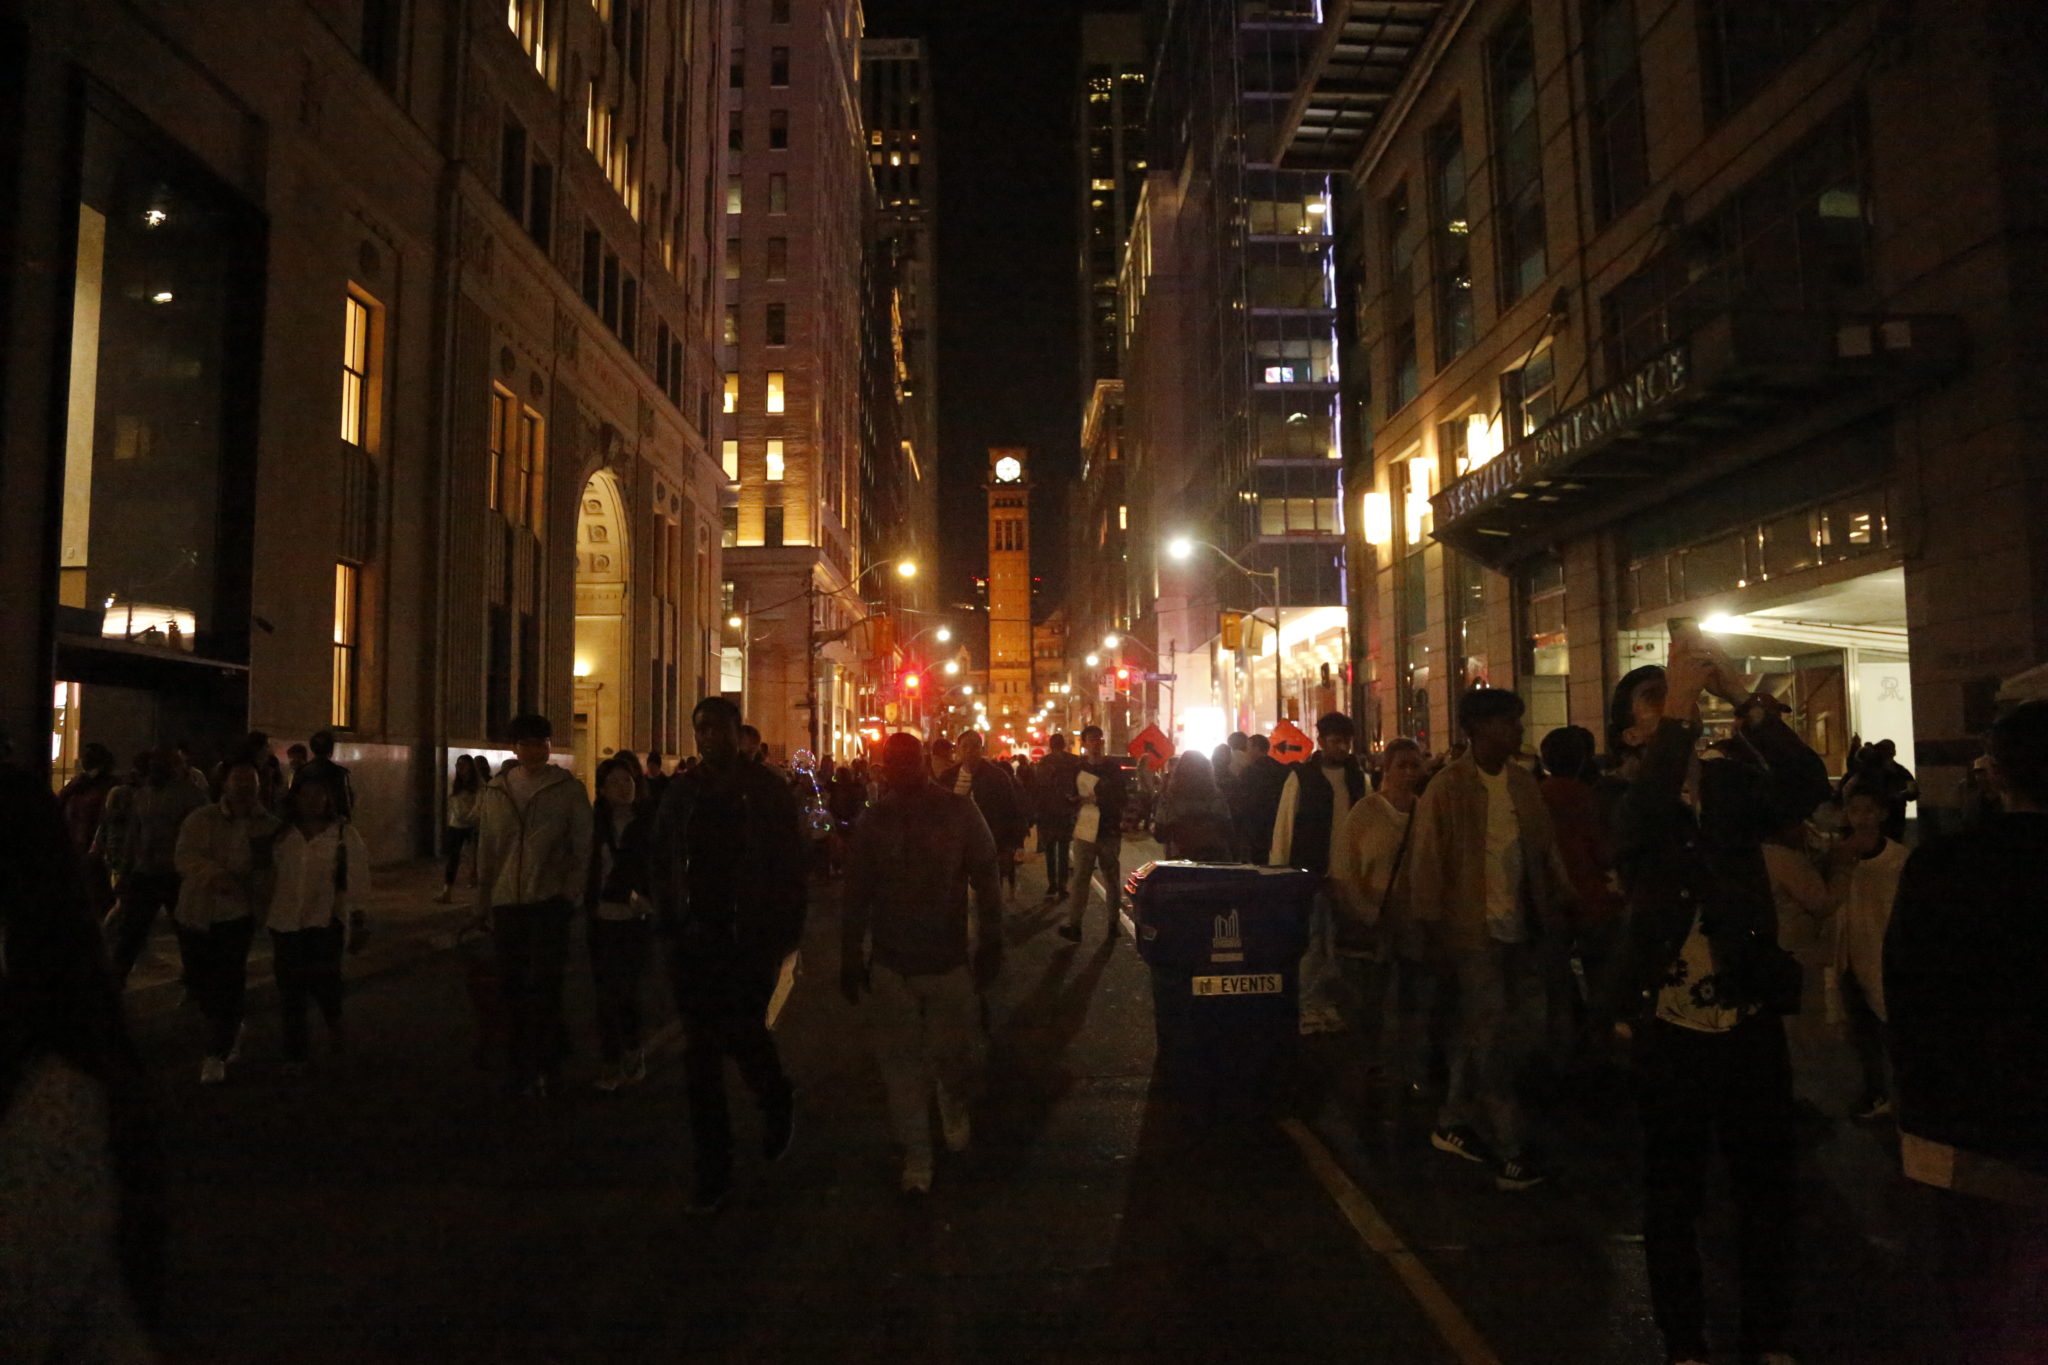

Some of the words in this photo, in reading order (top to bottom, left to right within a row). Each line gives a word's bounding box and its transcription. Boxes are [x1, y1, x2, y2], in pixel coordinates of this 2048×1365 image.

[1447, 451, 1523, 521] SERVICE
[1534, 348, 1684, 464] ENTRANCE
[1221, 976, 1275, 993] EVENTS
